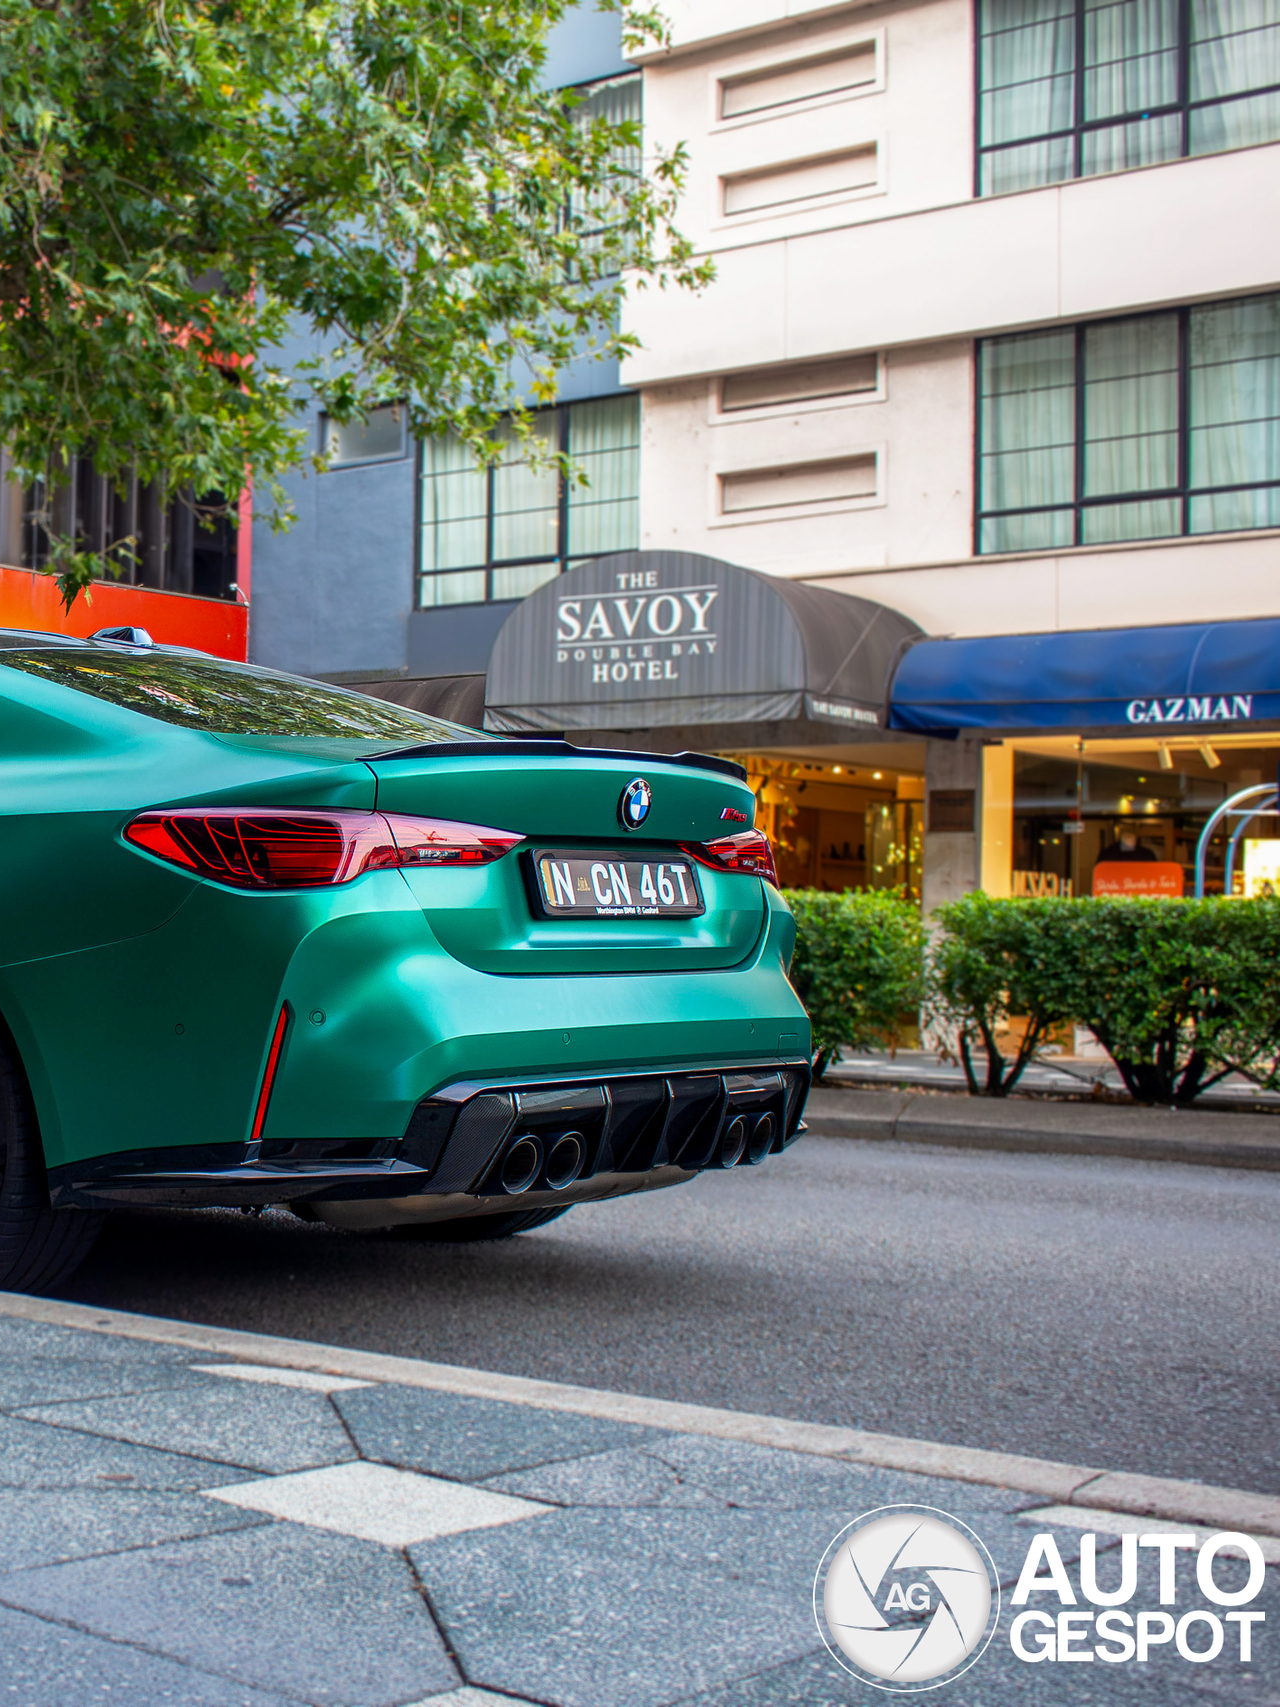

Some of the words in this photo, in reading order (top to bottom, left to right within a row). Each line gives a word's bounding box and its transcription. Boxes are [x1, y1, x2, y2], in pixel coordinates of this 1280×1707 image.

[616, 571, 658, 590] THE
[556, 592, 718, 642] SAVOY
[557, 646, 653, 663] DOUBLE
[672, 641, 717, 656] BAY
[592, 660, 679, 683] HOTEL
[1125, 694, 1253, 724] GAZMAN
[590, 863, 633, 905] CN
[640, 864, 690, 905] 46T
